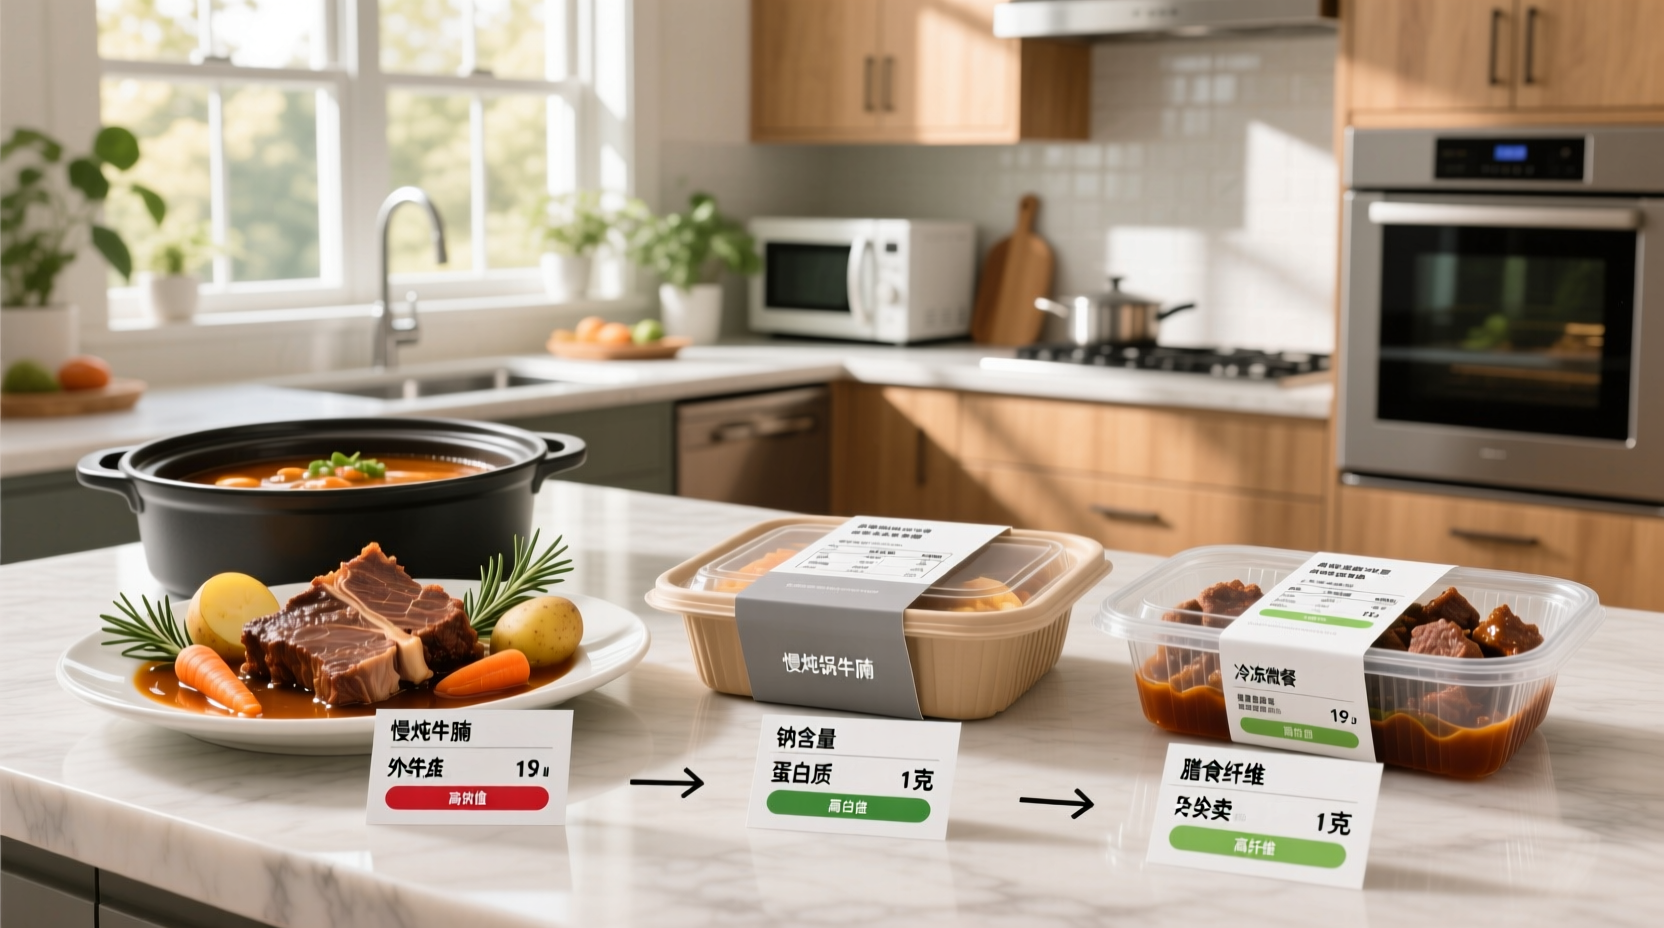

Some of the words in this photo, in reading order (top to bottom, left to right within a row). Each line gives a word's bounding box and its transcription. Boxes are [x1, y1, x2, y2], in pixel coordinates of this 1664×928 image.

[391, 719, 472, 742] 慢炖牛腩
[777, 725, 836, 749] 钠含量
[771, 761, 833, 785] 蛋白质
[901, 768, 934, 792] 1克
[1180, 758, 1266, 786] 膳食纤维
[1317, 811, 1353, 836] 1克
